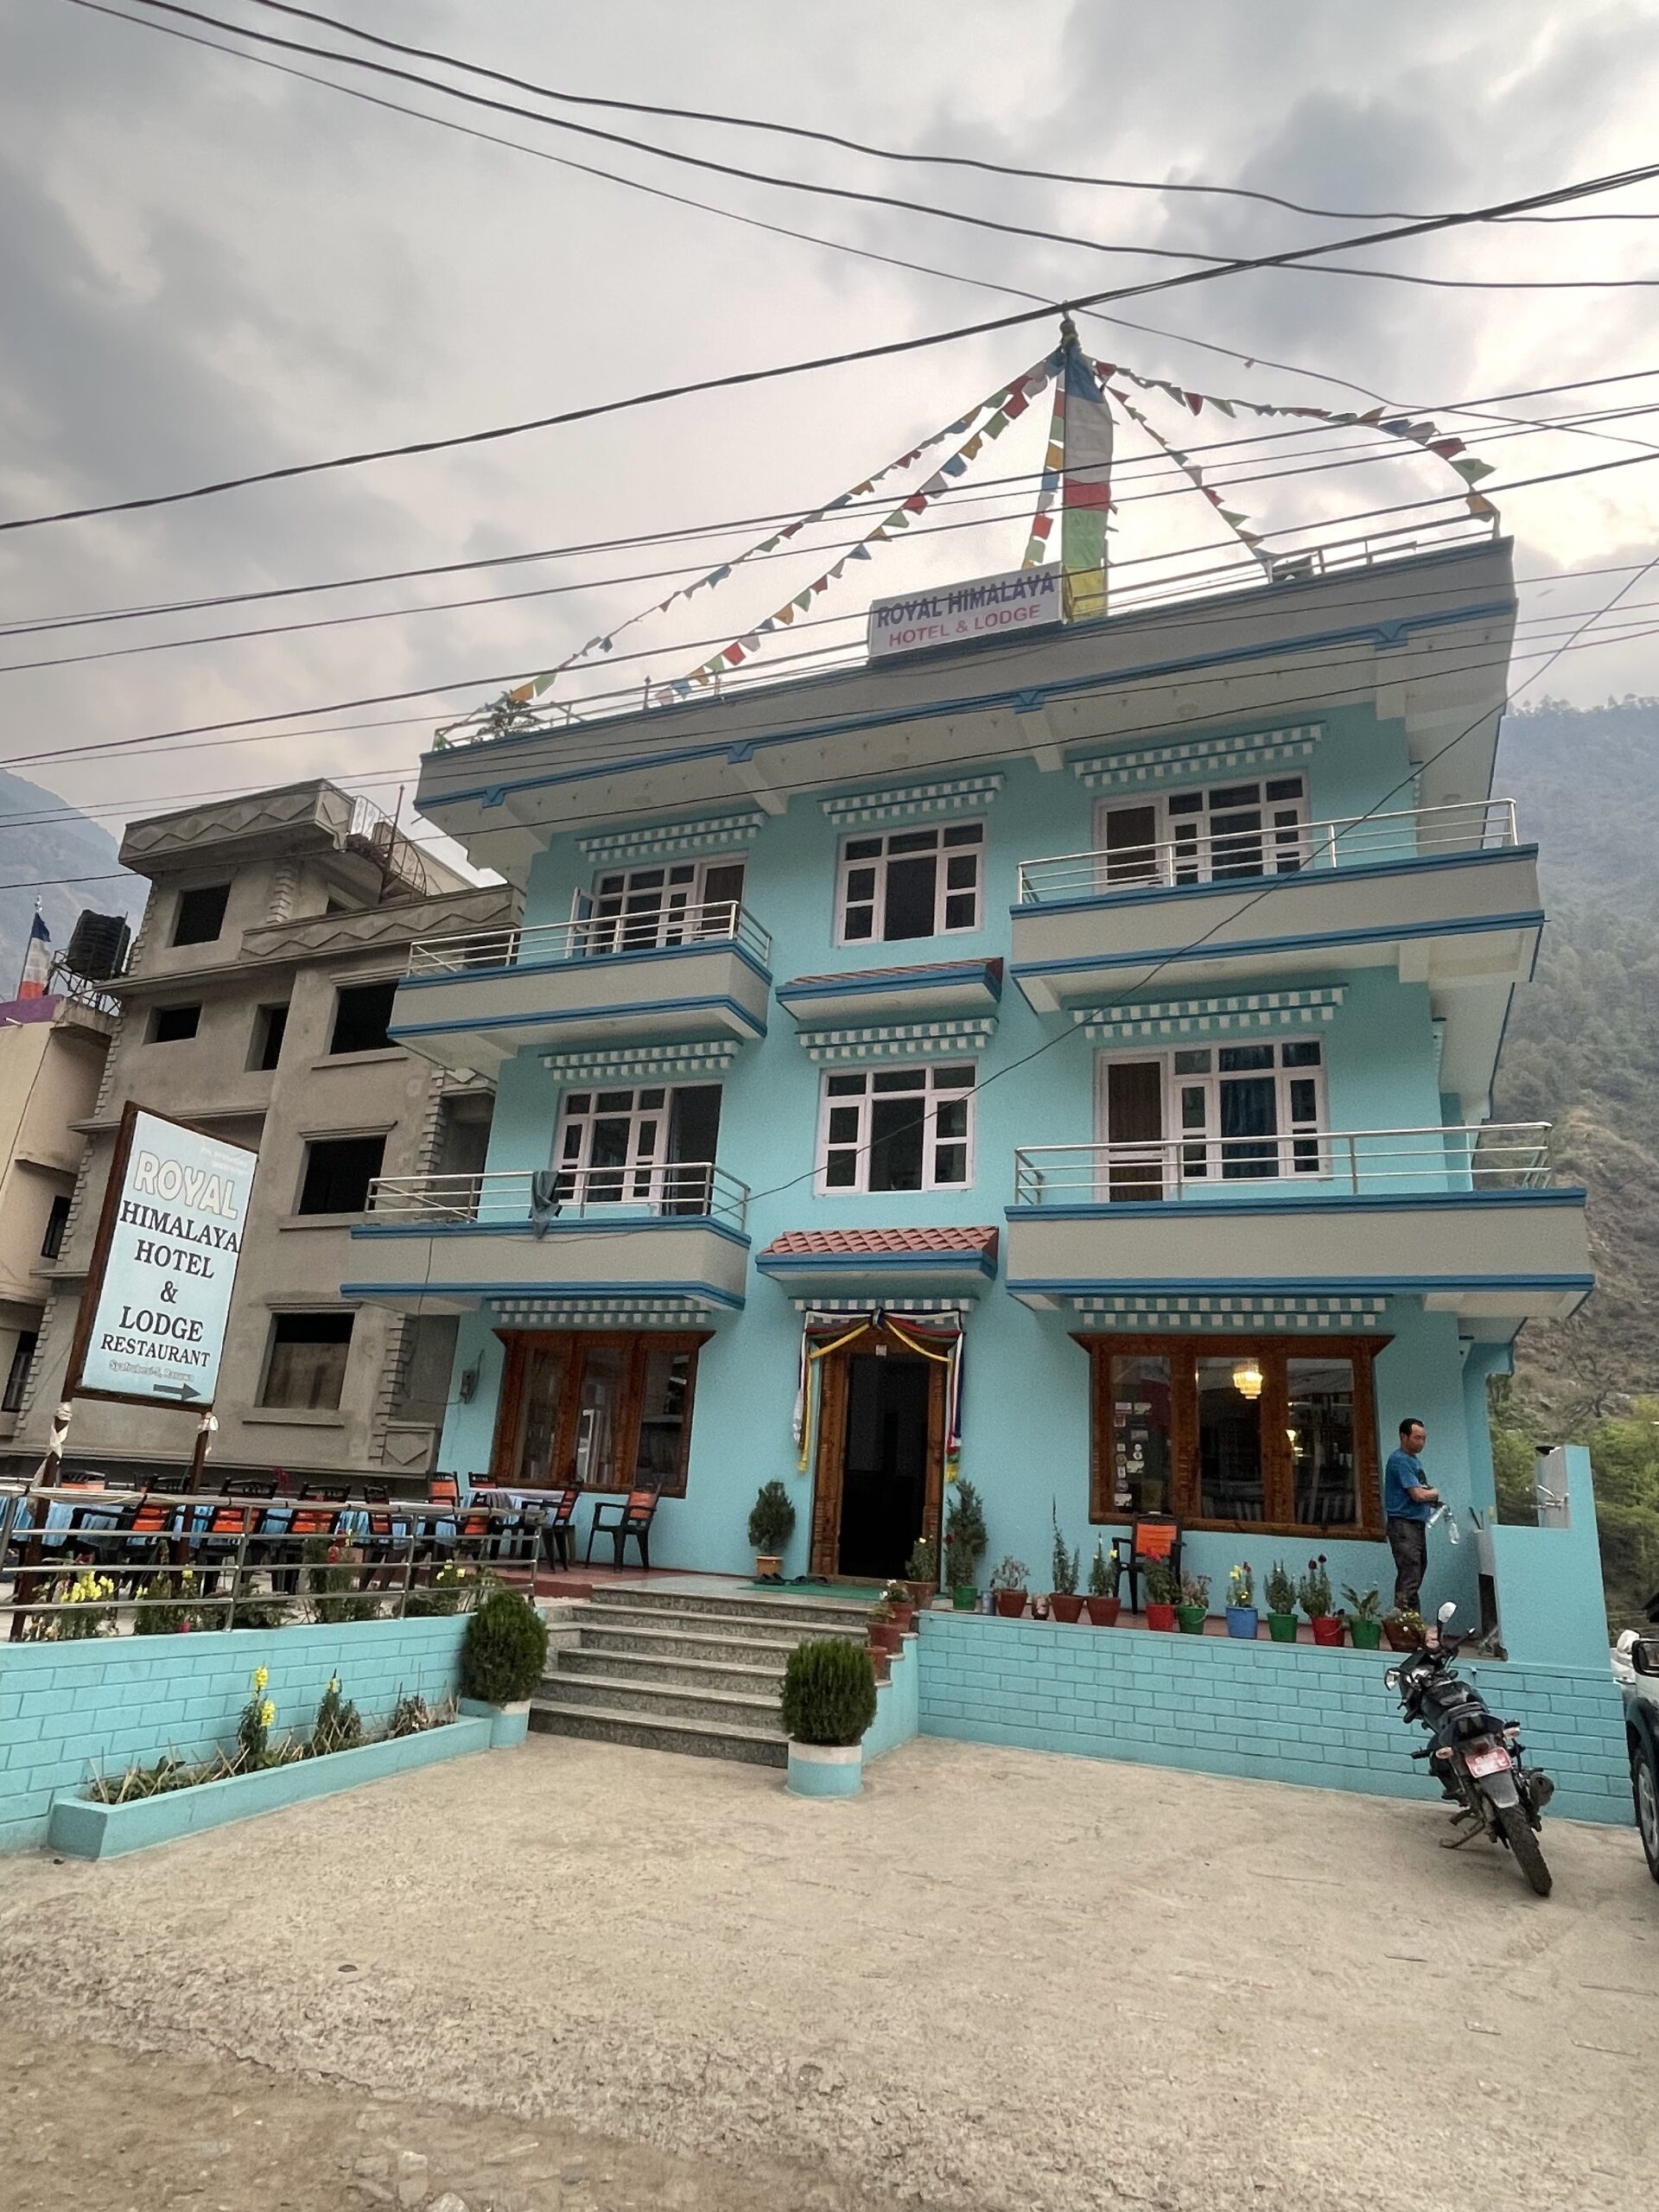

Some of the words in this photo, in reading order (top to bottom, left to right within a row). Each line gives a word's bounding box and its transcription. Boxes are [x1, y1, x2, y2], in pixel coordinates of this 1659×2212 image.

[877, 596, 943, 627] ROYAL
[948, 572, 1055, 614] HIMALAYA
[889, 626, 950, 646] HOTEL
[956, 620, 969, 633] &
[975, 605, 1041, 630] LODGE
[133, 1150, 238, 1219] ROYAL
[119, 1200, 239, 1253] HIMALAYA
[135, 1239, 213, 1279] HOTEL
[160, 1281, 178, 1304] &
[119, 1306, 204, 1342] LODGE
[100, 1333, 210, 1367] RESTAURANT
